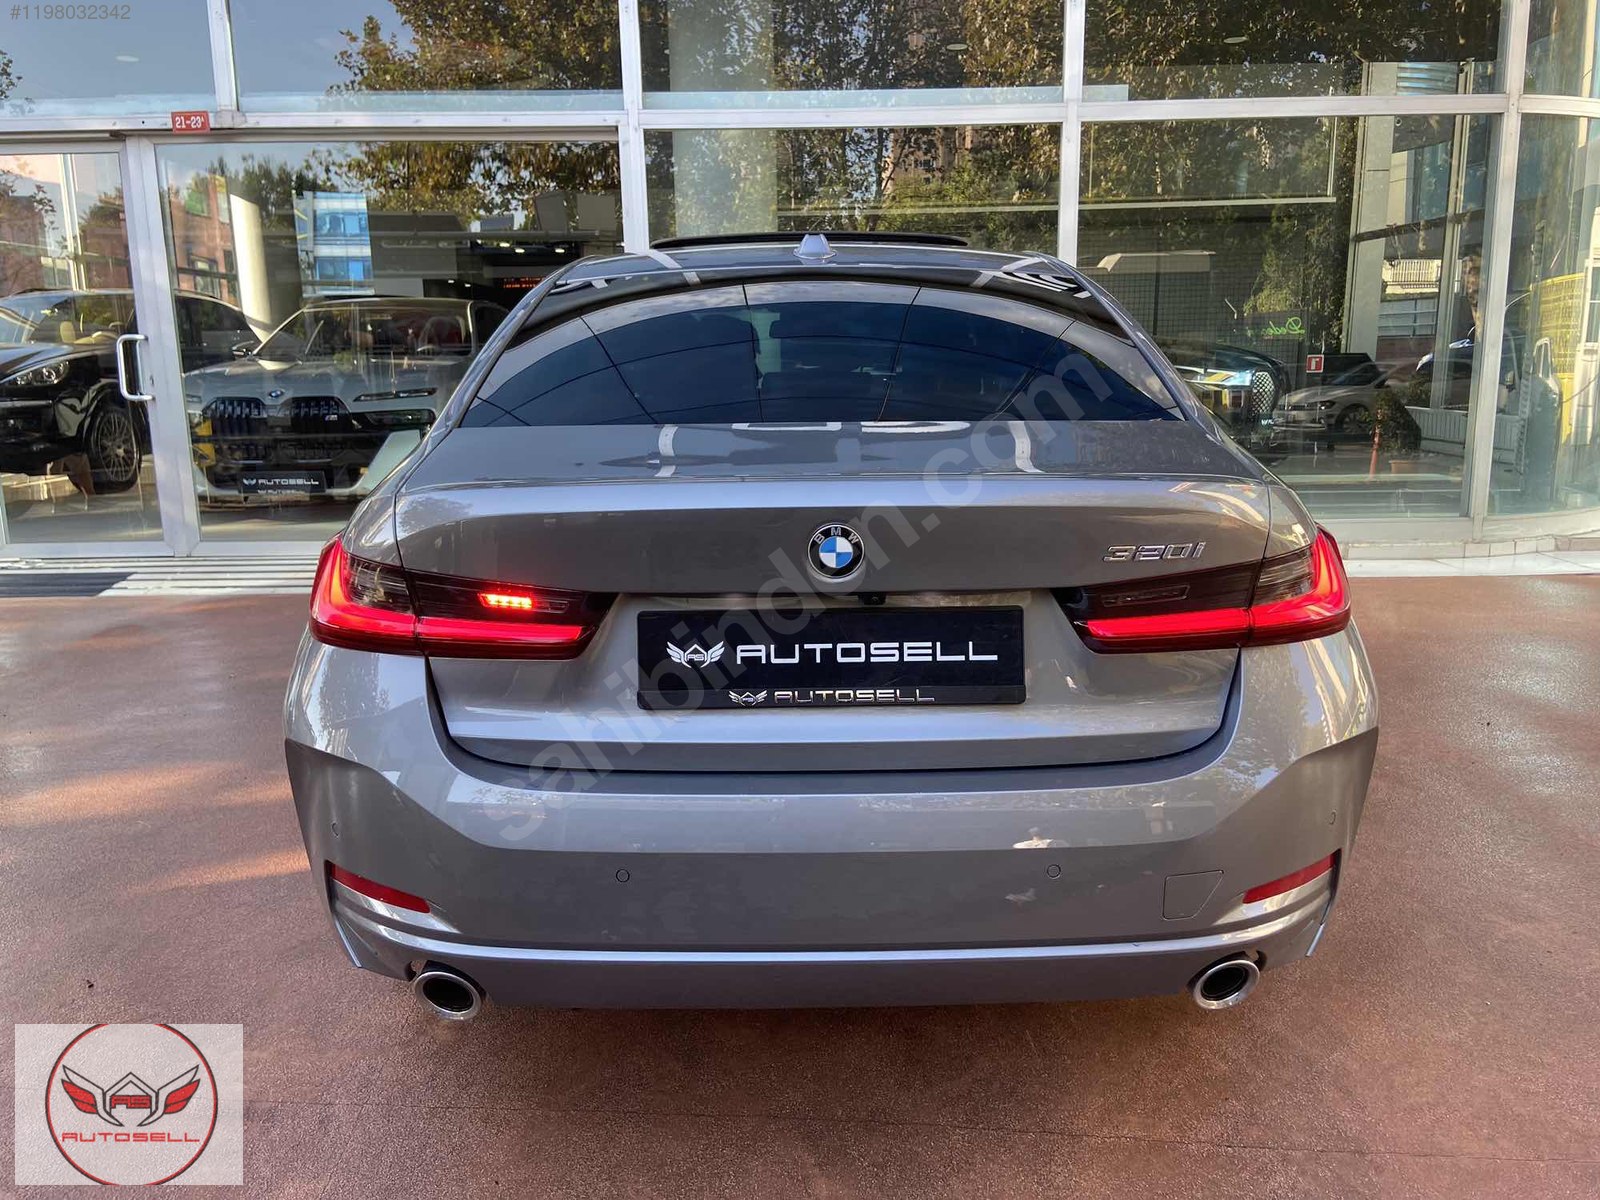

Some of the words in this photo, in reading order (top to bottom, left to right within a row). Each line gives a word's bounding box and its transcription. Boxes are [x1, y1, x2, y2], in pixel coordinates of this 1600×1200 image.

[813, 526, 859, 545] BMW
[1103, 542, 1206, 562] 320i
[736, 641, 999, 665] AUTOSELL
[774, 688, 936, 704] AUTOSELL
